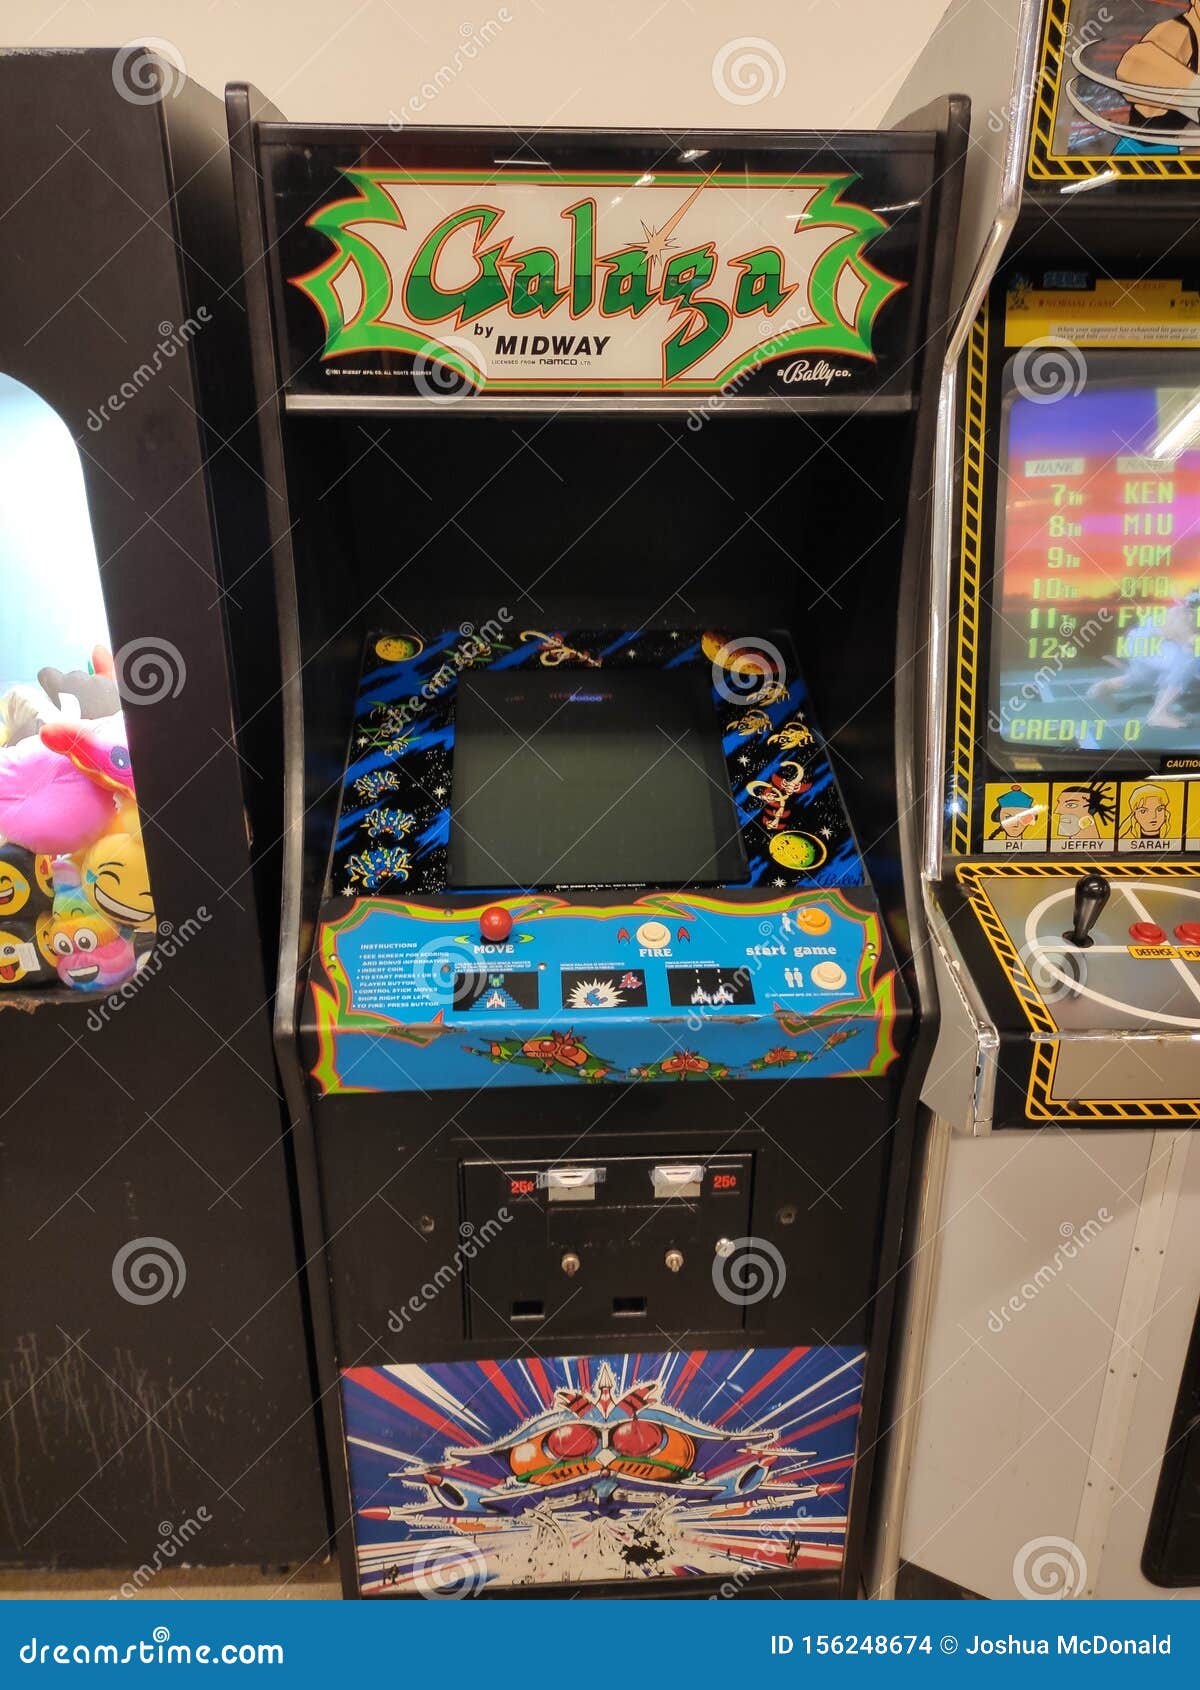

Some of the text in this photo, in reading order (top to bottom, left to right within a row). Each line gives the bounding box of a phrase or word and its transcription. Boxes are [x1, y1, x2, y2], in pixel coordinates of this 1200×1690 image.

[402, 197, 800, 388] Galaga
[474, 323, 494, 339] by
[495, 335, 611, 356] MIDWAY
[539, 358, 578, 366] namco
[783, 360, 836, 386] Bally
[835, 368, 852, 377] co.
[1124, 481, 1174, 505] KEN
[1122, 513, 1173, 536] MIU
[1121, 544, 1172, 568] YAM
[1119, 576, 1170, 599] OTA
[1008, 718, 1108, 742] CREDIT
[1166, 759, 1200, 768] CAUTIO
[1005, 841, 1023, 850] PAI
[1061, 840, 1104, 850] JEFFRY
[1130, 840, 1171, 850] SARAH
[360, 942, 418, 950] INSTRUCTIONS
[473, 944, 515, 954] MOVE
[638, 948, 673, 958] FIRE
[745, 944, 837, 958] start game
[712, 1174, 738, 1190] 25¢
